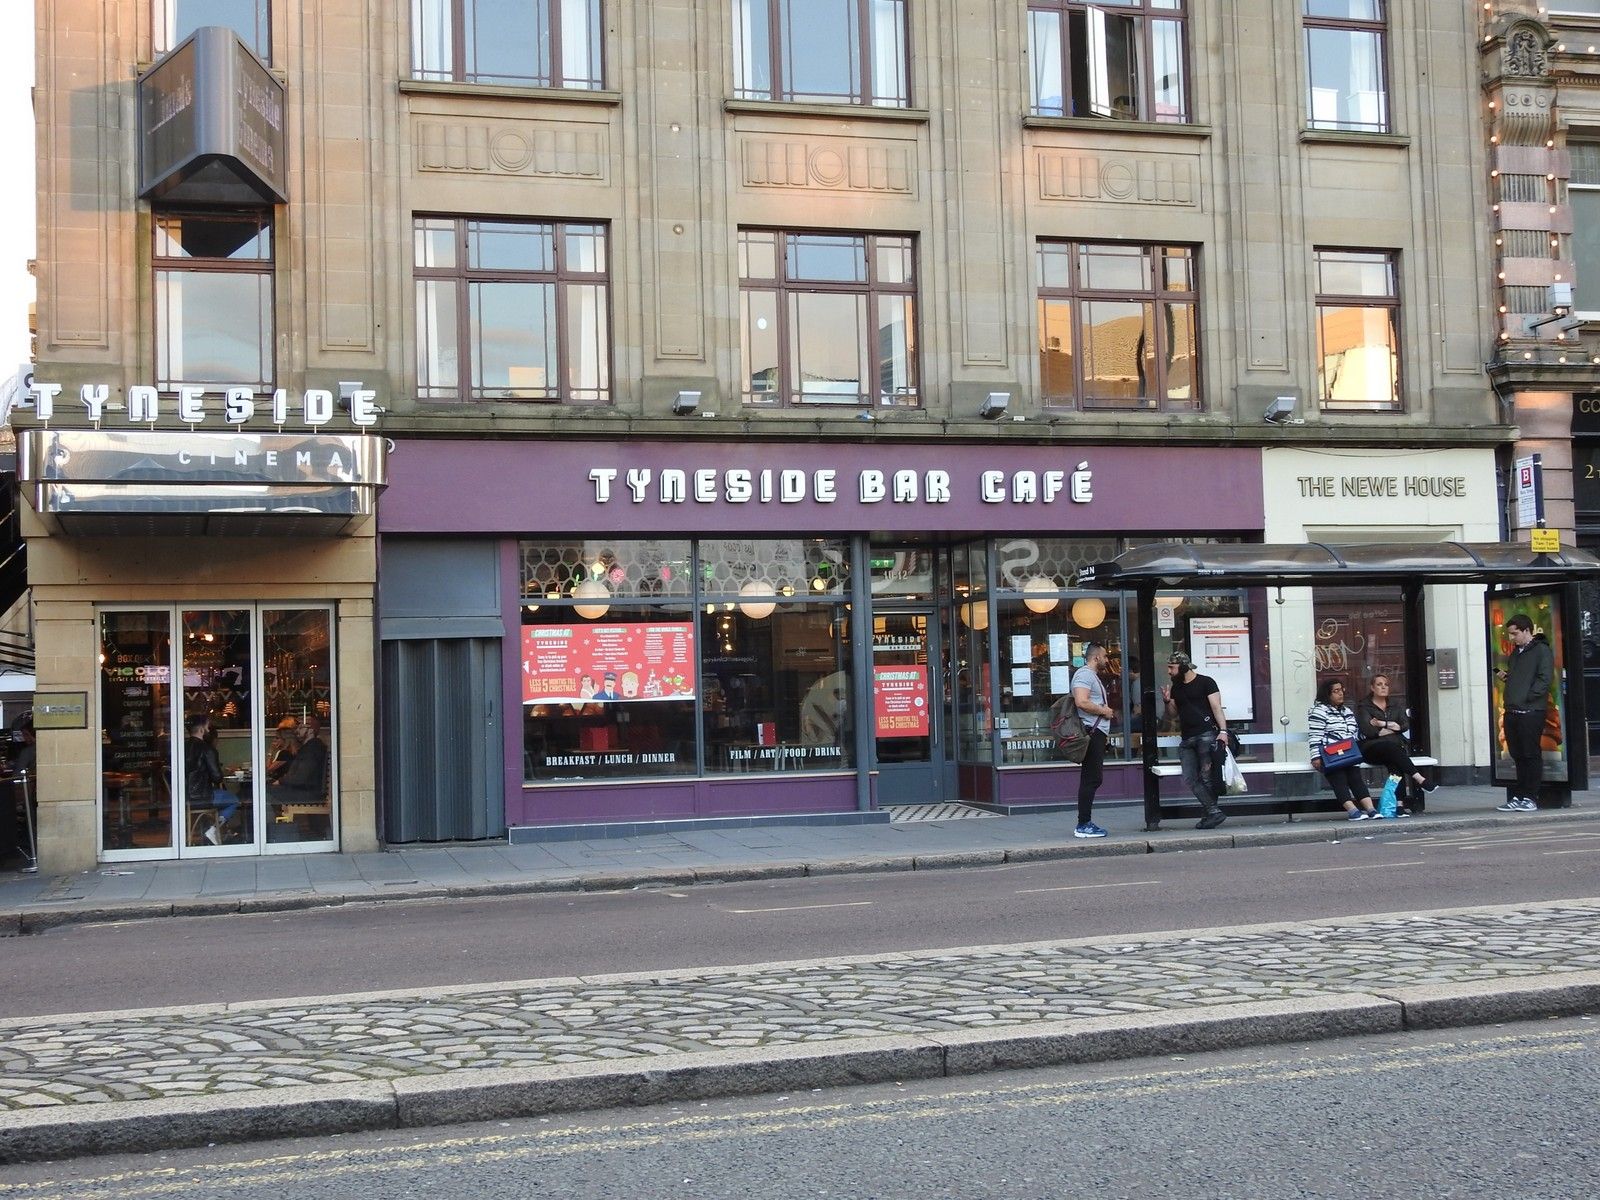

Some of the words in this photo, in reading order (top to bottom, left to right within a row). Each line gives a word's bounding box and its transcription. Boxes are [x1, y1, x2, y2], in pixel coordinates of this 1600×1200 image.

[29, 383, 377, 425] TYNESIDE
[178, 447, 343, 466] CINEMA
[588, 467, 837, 503] TYNESIDE
[859, 469, 951, 503] BAR
[981, 461, 1094, 503] CAFÉ
[1297, 476, 1335, 497] THE
[1341, 476, 1398, 497] NEWE
[1404, 476, 1467, 497] HOUSE
[730, 750, 751, 760] FILM
[760, 749, 777, 759] ART
[784, 748, 807, 758] FOOD
[815, 747, 841, 756] DRINK
[1006, 739, 1050, 750] BREAKFAST
[546, 755, 596, 766] BREAKFAST
[605, 754, 633, 764] LUNCH
[642, 752, 676, 763] DINNER
